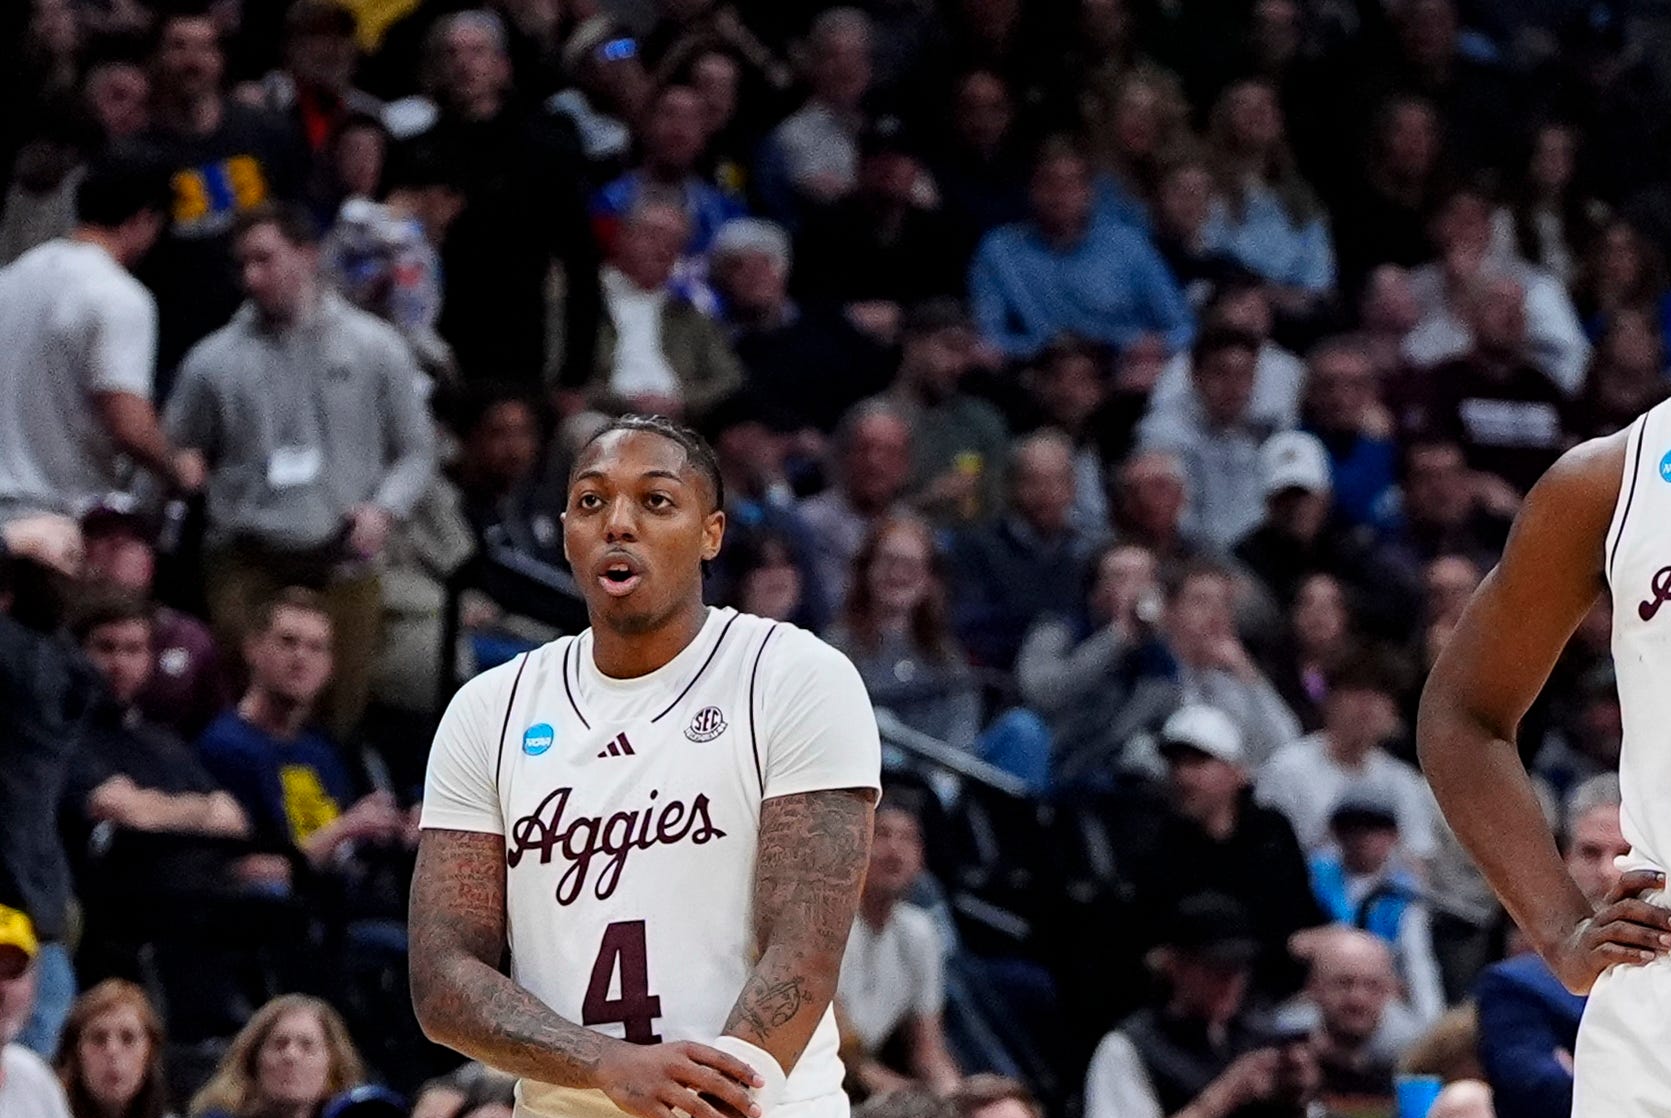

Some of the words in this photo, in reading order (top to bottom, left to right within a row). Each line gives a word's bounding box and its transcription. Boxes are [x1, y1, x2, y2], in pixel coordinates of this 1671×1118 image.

[694, 708, 719, 732] SEC
[507, 786, 728, 907] Aggies
[581, 919, 663, 1046] 4
